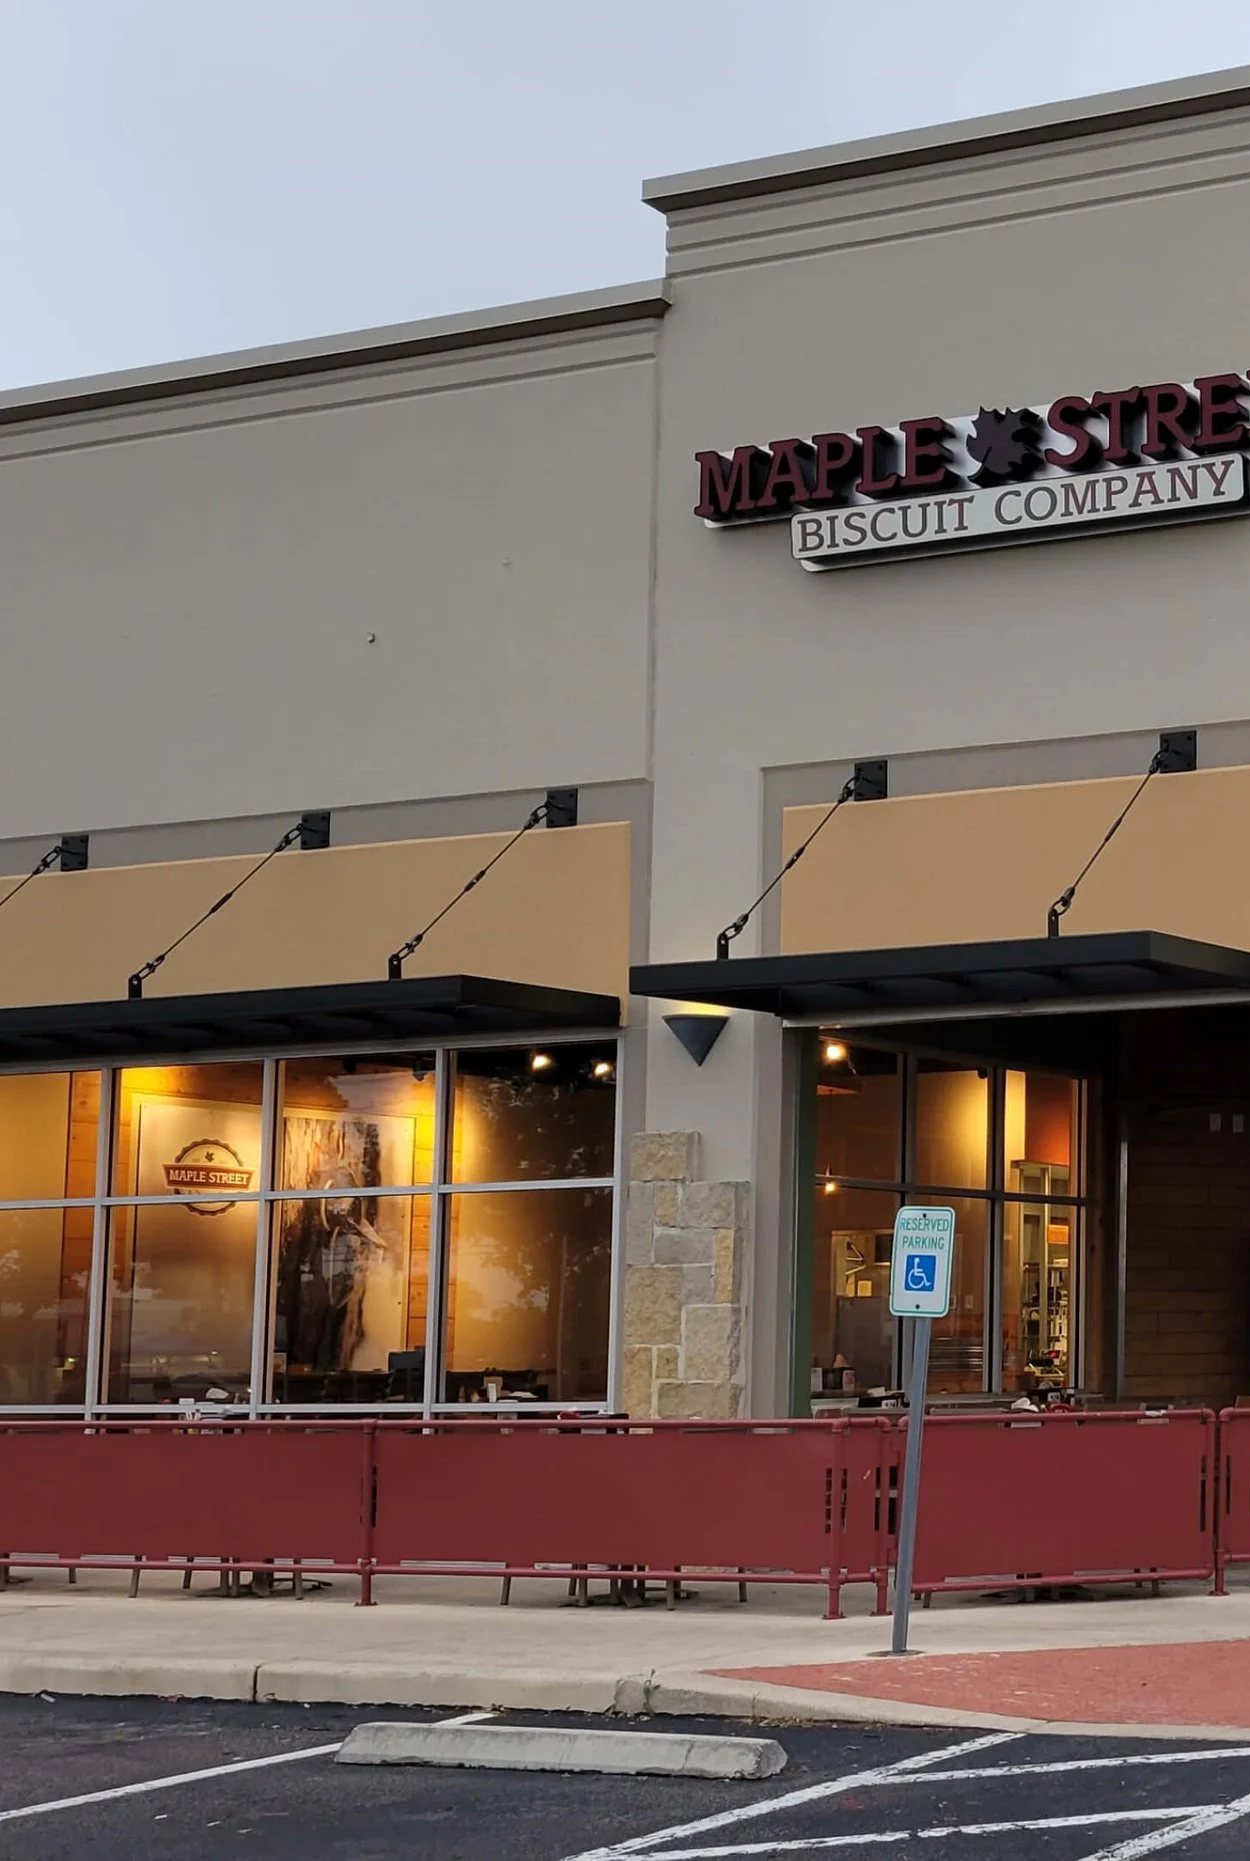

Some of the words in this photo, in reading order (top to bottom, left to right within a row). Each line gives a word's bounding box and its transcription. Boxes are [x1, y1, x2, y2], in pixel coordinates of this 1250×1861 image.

[694, 416, 948, 520] MAPLE
[797, 495, 974, 553] BISCUIT
[994, 459, 1235, 526] COMPANY
[170, 1169, 206, 1182] MAPLE
[208, 1172, 249, 1184] STREET
[900, 1217, 949, 1231] RESERVED
[903, 1236, 944, 1250] PARKING
